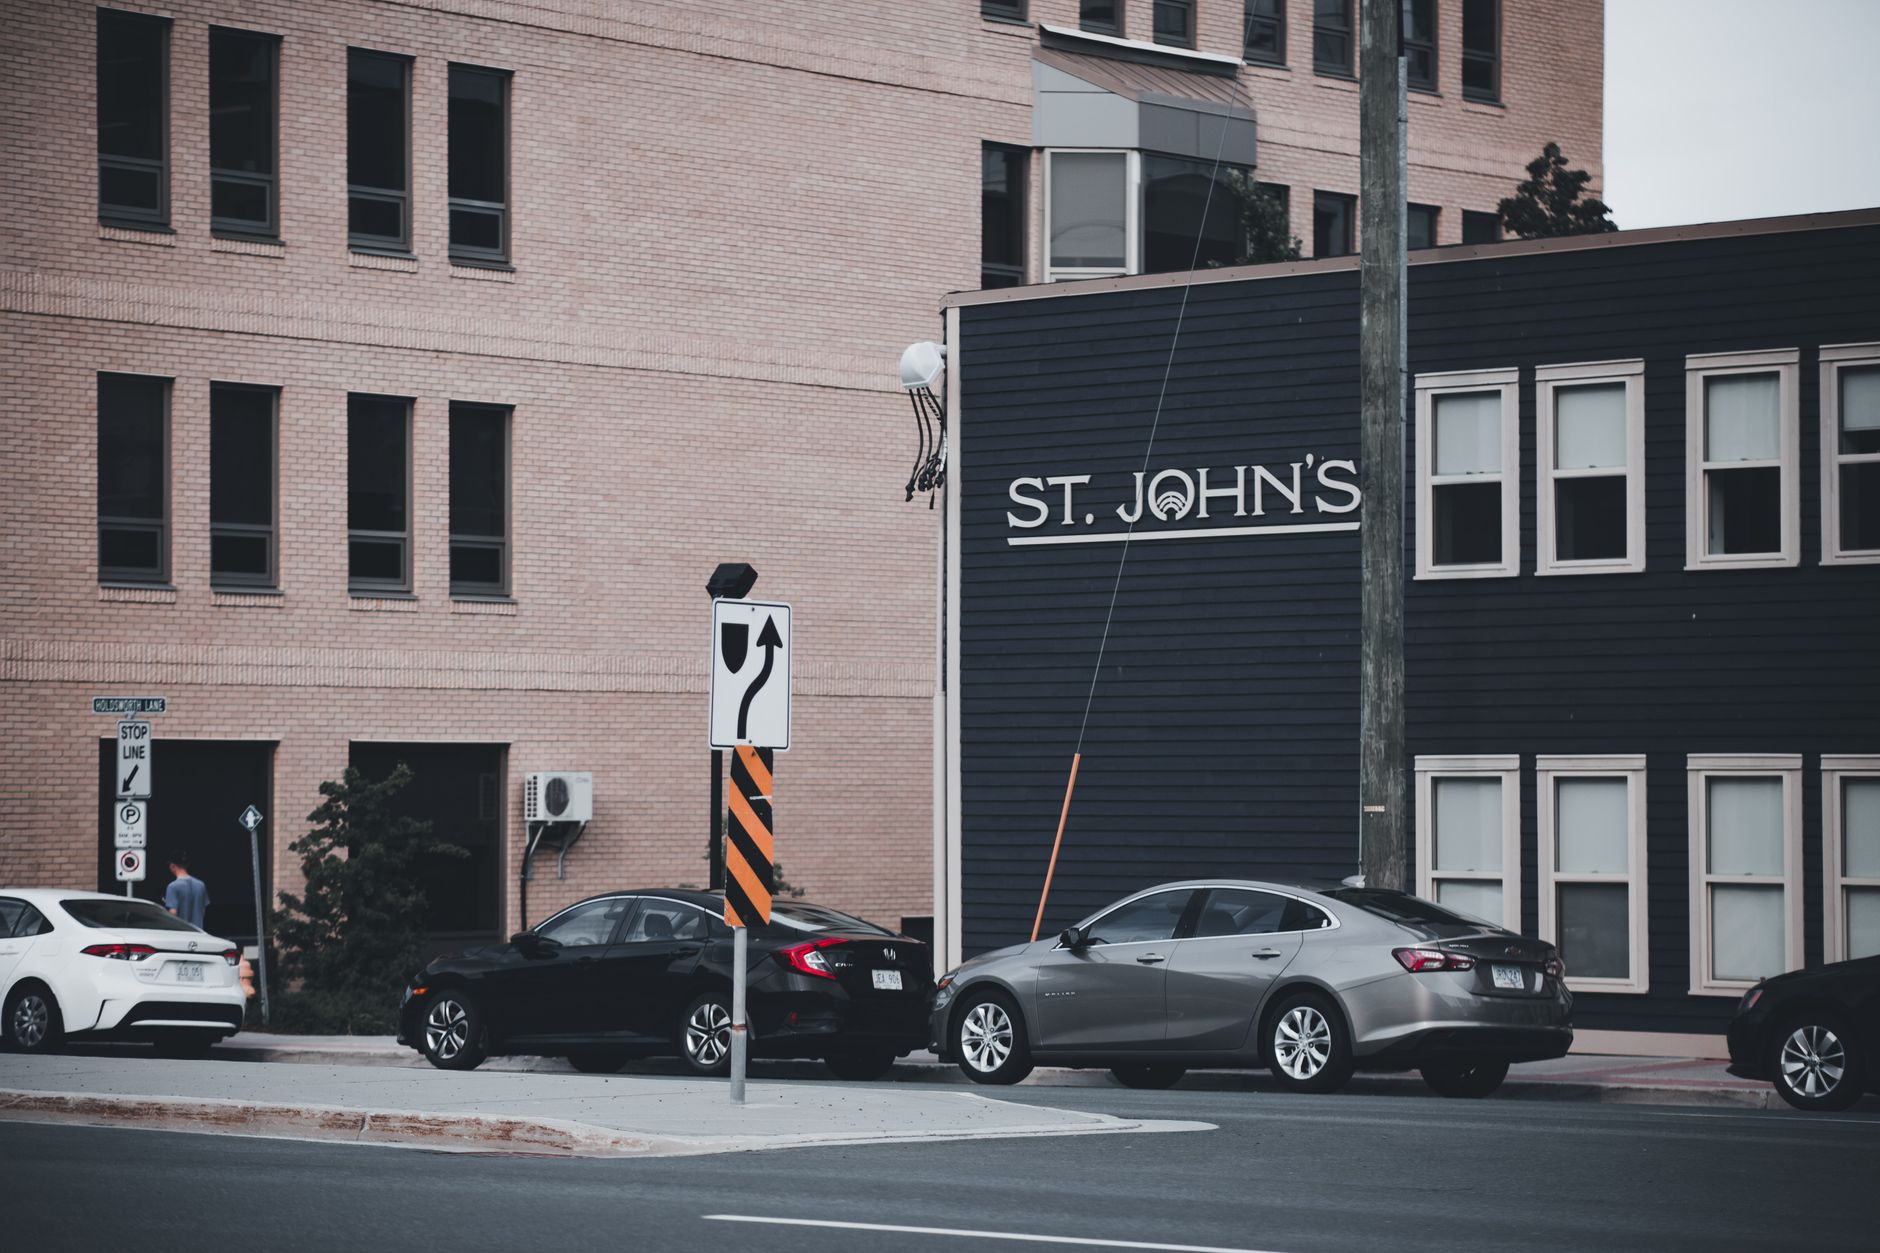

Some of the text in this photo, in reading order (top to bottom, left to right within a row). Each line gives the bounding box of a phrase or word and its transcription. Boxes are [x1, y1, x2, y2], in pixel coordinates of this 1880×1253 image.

[1007, 453, 1362, 528] ST. JOHN'S
[95, 699, 164, 712] HOLDSWORTH LANE
[121, 725, 147, 740] STOP
[123, 745, 145, 760] LINE
[125, 808, 137, 821] P
